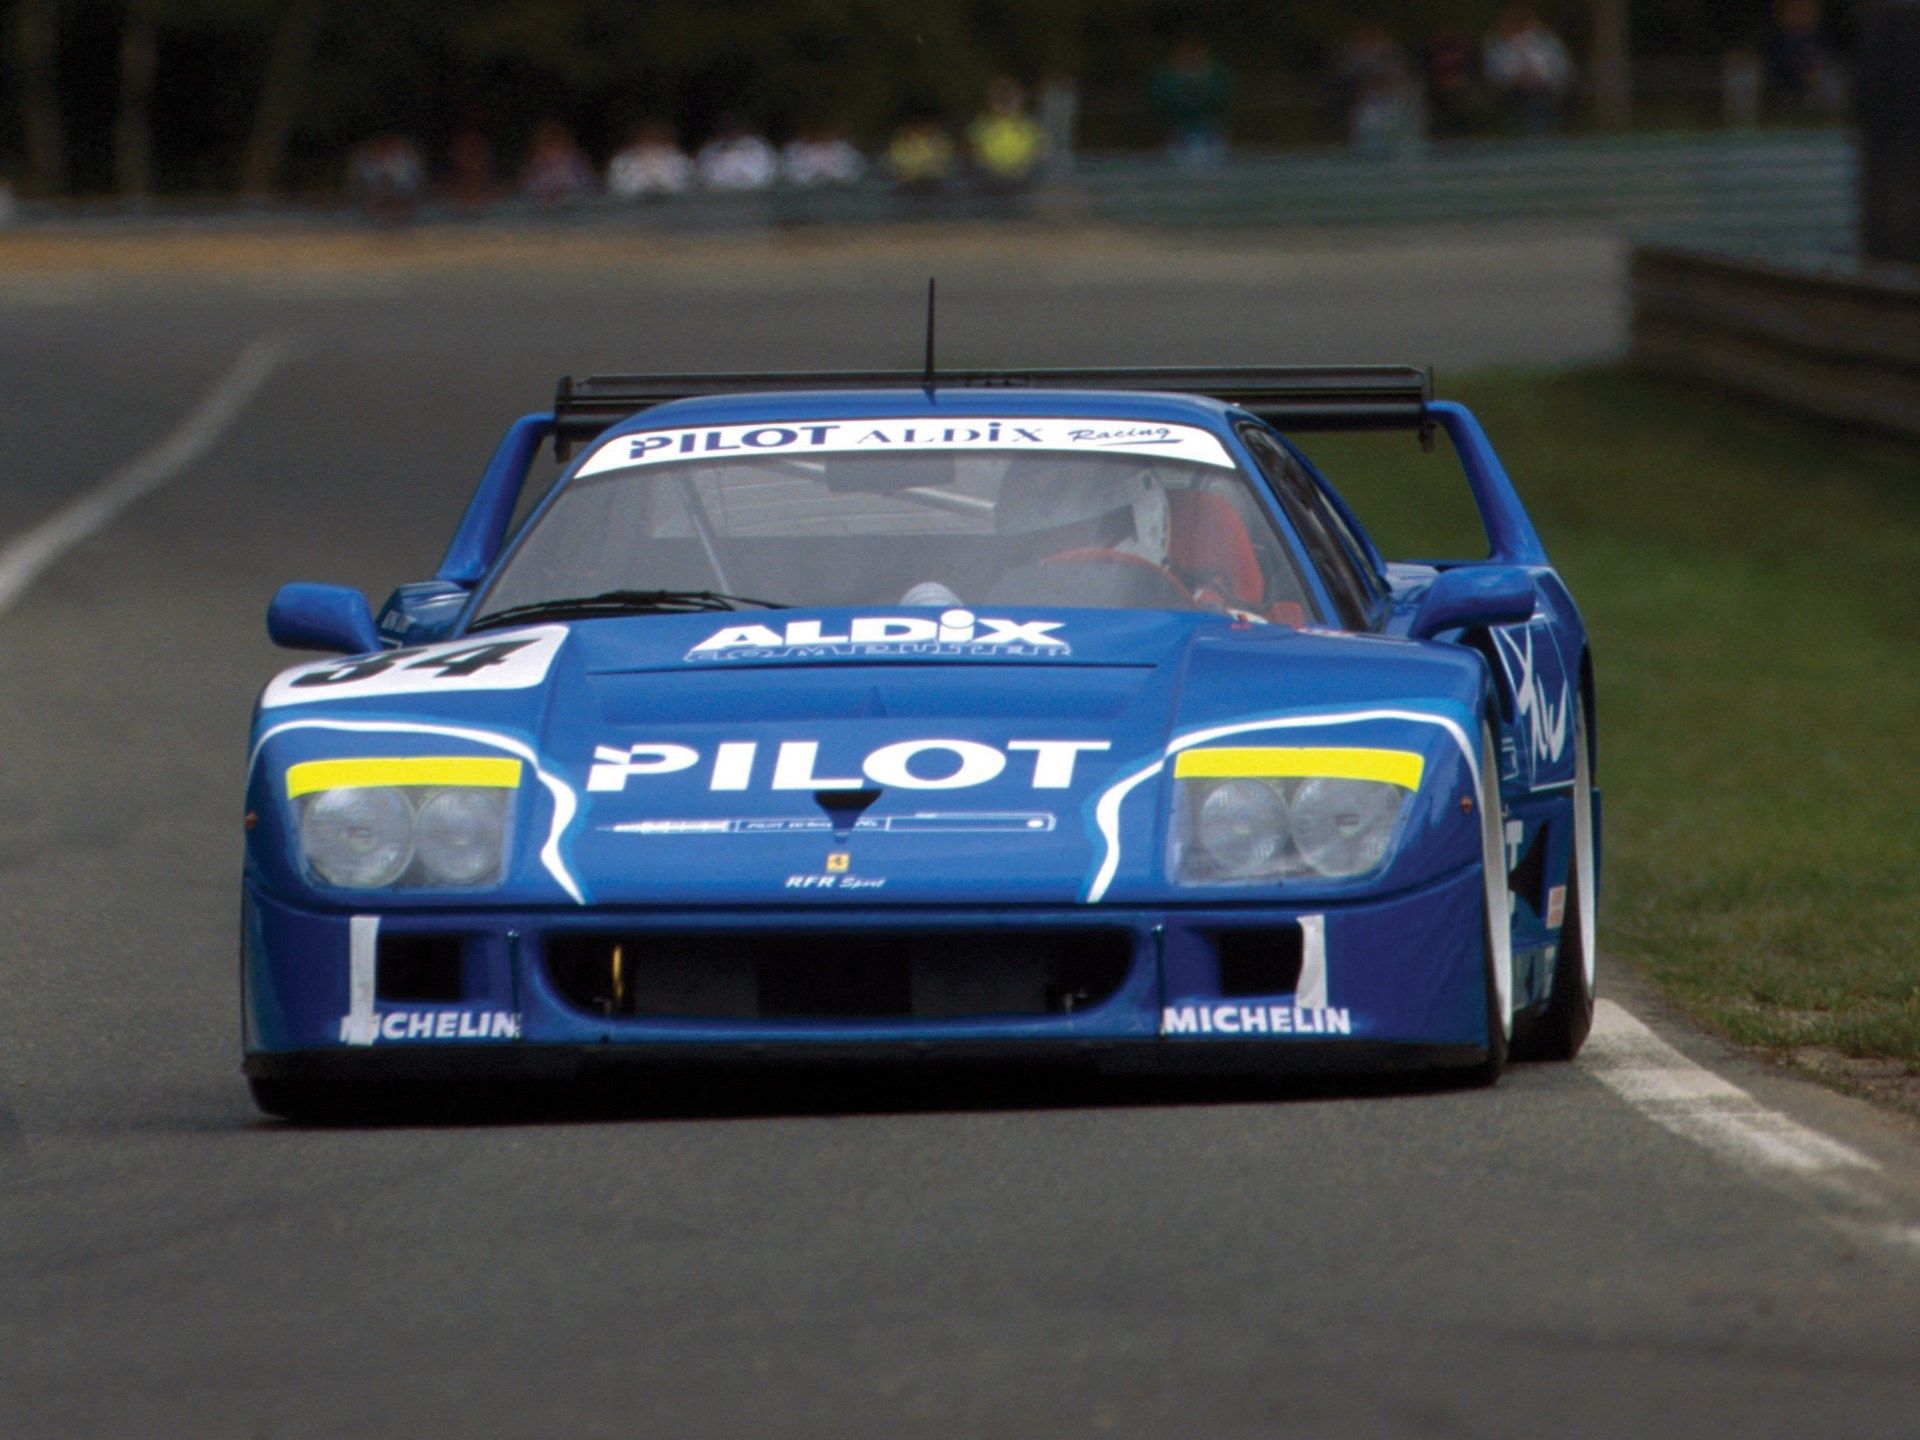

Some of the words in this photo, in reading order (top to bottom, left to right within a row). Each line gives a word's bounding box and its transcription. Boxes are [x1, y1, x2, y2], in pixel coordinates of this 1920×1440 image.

[629, 425, 841, 459] PILOT
[1067, 427, 1171, 443] Racing
[289, 637, 542, 688] 34
[586, 739, 1112, 792] PILOT
[785, 875, 836, 888] RFR
[838, 876, 885, 890] Sport
[1161, 1005, 1351, 1035] MICHELIN
